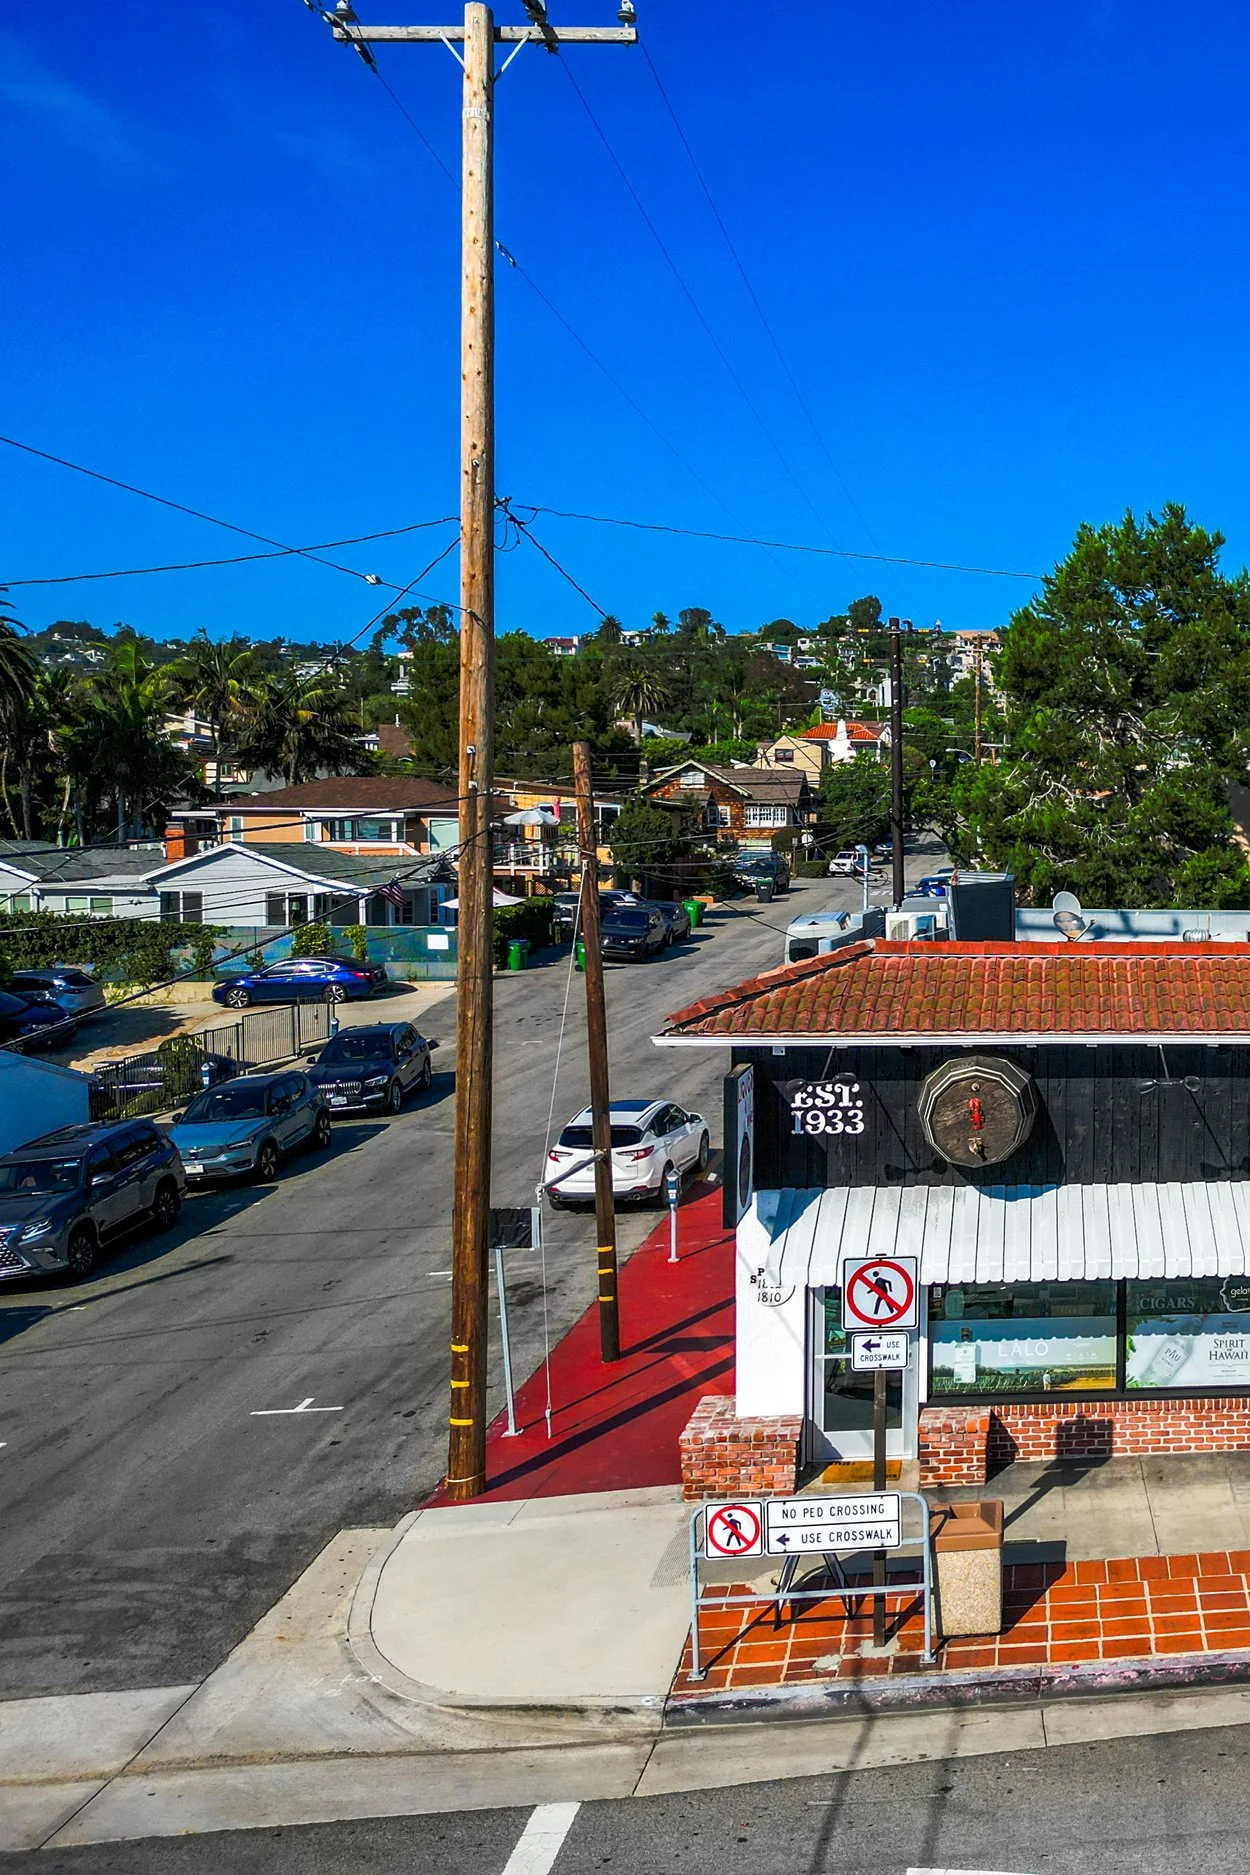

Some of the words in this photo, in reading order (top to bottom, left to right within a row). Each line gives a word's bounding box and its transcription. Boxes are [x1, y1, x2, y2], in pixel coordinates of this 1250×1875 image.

[790, 1083, 863, 1108] EST.
[790, 1109, 865, 1135] 1933
[757, 1291, 782, 1303] 1810
[1139, 1297, 1196, 1310] CIGARS
[886, 1340, 901, 1349] USE
[998, 1341, 1049, 1357] LALO
[1213, 1338, 1246, 1349] SPIRIT
[860, 1353, 901, 1362] CROSSWALK
[782, 1508, 797, 1520] NO
[803, 1507, 824, 1518] PED
[829, 1503, 885, 1517] CROSSING
[801, 1532, 822, 1544] USE
[828, 1529, 893, 1543] CROSSWALK
